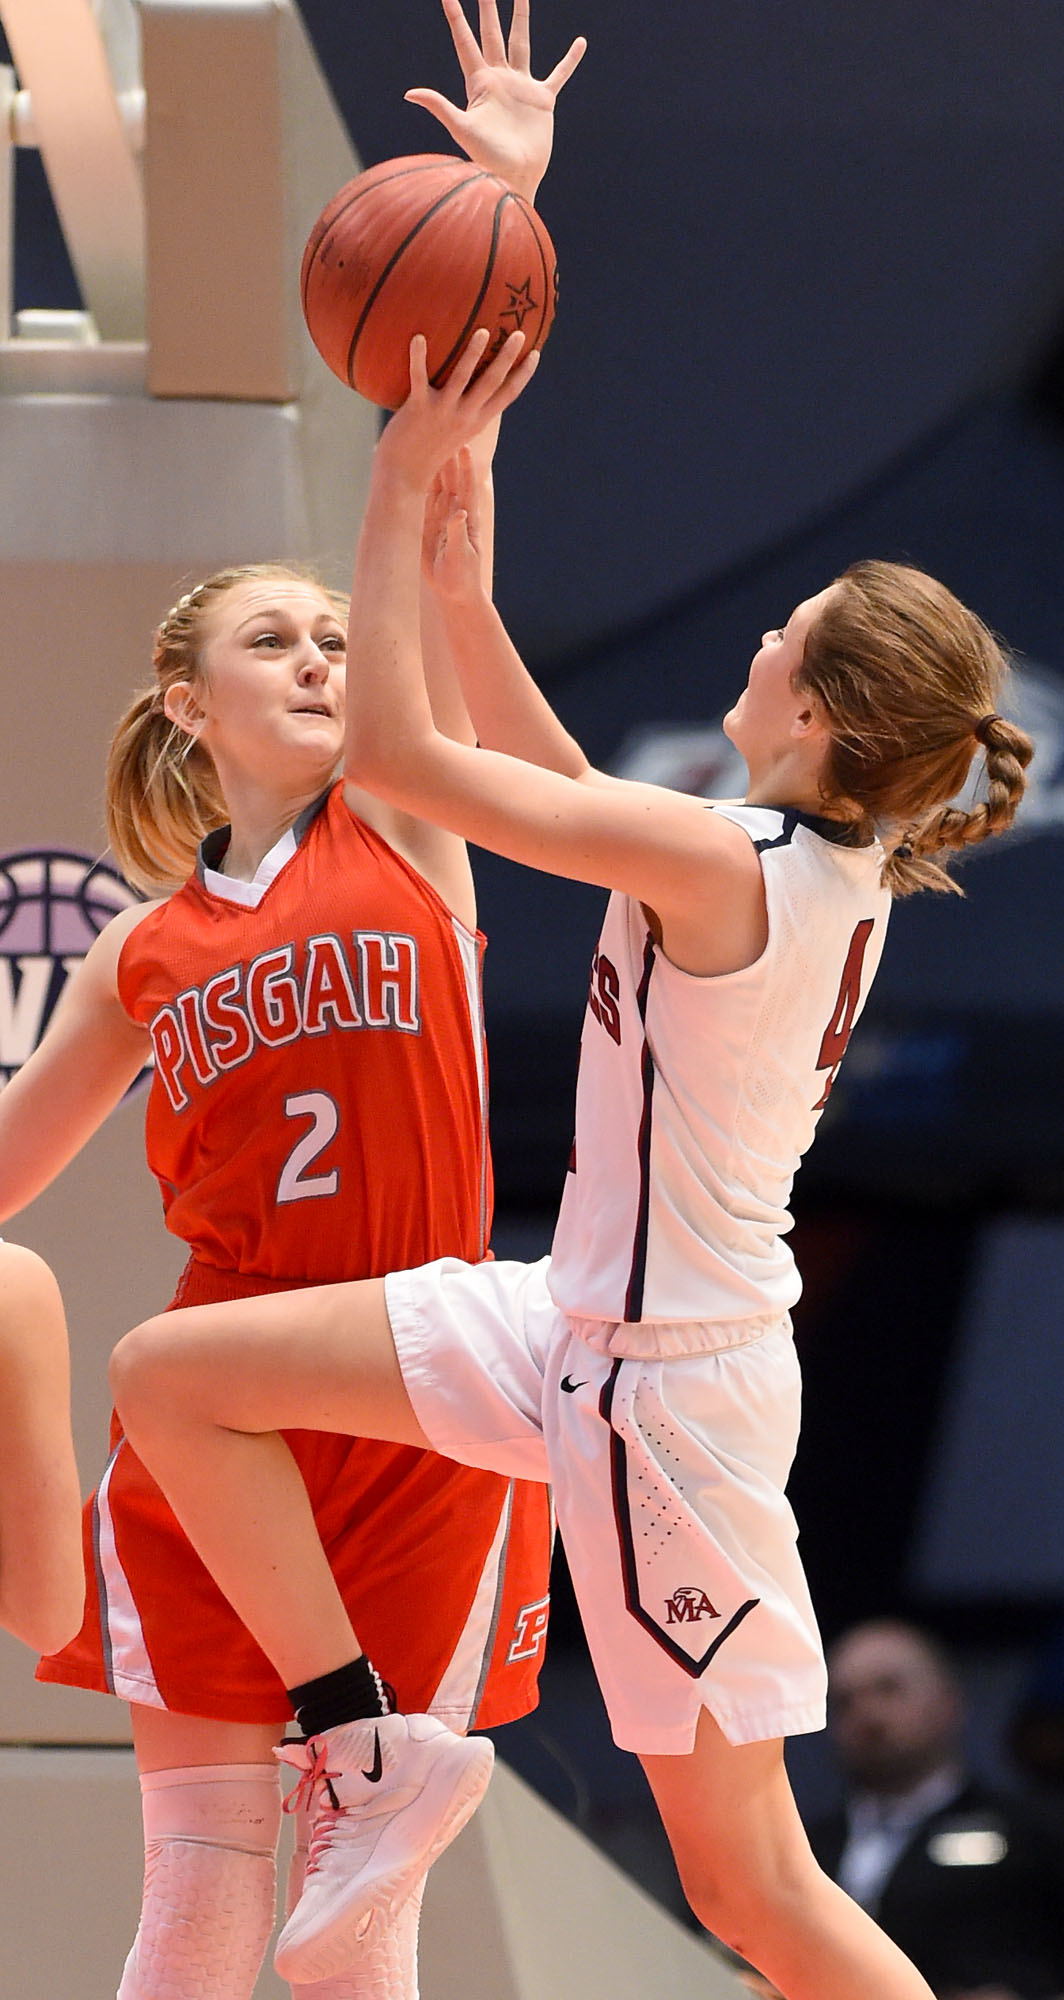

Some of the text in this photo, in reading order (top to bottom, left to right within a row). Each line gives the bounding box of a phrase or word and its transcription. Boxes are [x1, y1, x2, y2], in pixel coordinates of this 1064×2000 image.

[149, 930, 422, 1114] PISGAH
[811, 917, 875, 1111] 4
[276, 1090, 341, 1206] 2
[664, 1590, 722, 1625] MA
